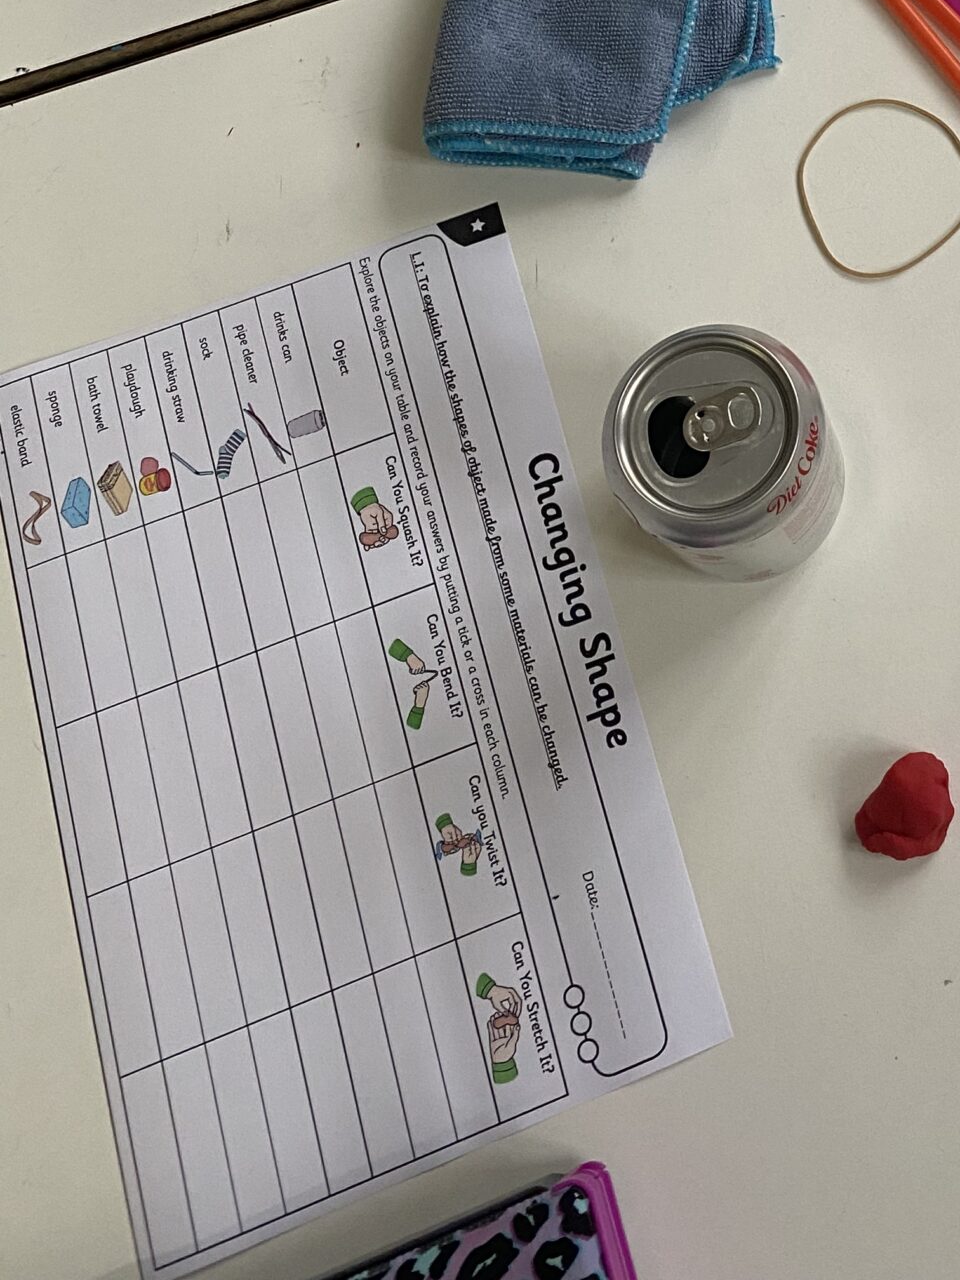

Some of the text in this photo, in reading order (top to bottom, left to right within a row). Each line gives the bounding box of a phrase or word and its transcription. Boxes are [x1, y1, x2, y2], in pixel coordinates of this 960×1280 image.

[414, 273, 430, 295] To
[272, 310, 293, 365] drinks can
[420, 293, 444, 343] explain
[198, 336, 214, 362] sock
[231, 323, 259, 384] pipe cleaner
[331, 338, 350, 377] Object
[433, 339, 452, 372] how
[85, 374, 110, 434] bath towel
[119, 362, 147, 420] playdough
[161, 350, 186, 424] drinking straw
[441, 369, 457, 395] the
[44, 389, 64, 429] sponge
[447, 392, 470, 441] shapes
[9, 404, 33, 469] elastic band
[460, 439, 478, 458] of
[464, 456, 487, 499] object
[766, 473, 803, 516] Diet
[797, 420, 820, 476] Coke
[357, 255, 510, 801] Explore the objects on your table and record your answers by putting a tick or a cross in each column.
[384, 454, 425, 567] Can You Squash It?
[476, 496, 498, 538] made
[485, 535, 506, 573] from
[496, 570, 516, 610] some
[527, 452, 628, 750] Changing Shape
[426, 613, 464, 719] Can You Bend It?
[506, 608, 537, 677] materials
[525, 675, 543, 706] can
[533, 702, 549, 726] be
[539, 724, 569, 790] changed.
[468, 774, 508, 887] Can you Twist It?
[510, 940, 556, 1074] Can You Stretch It?
